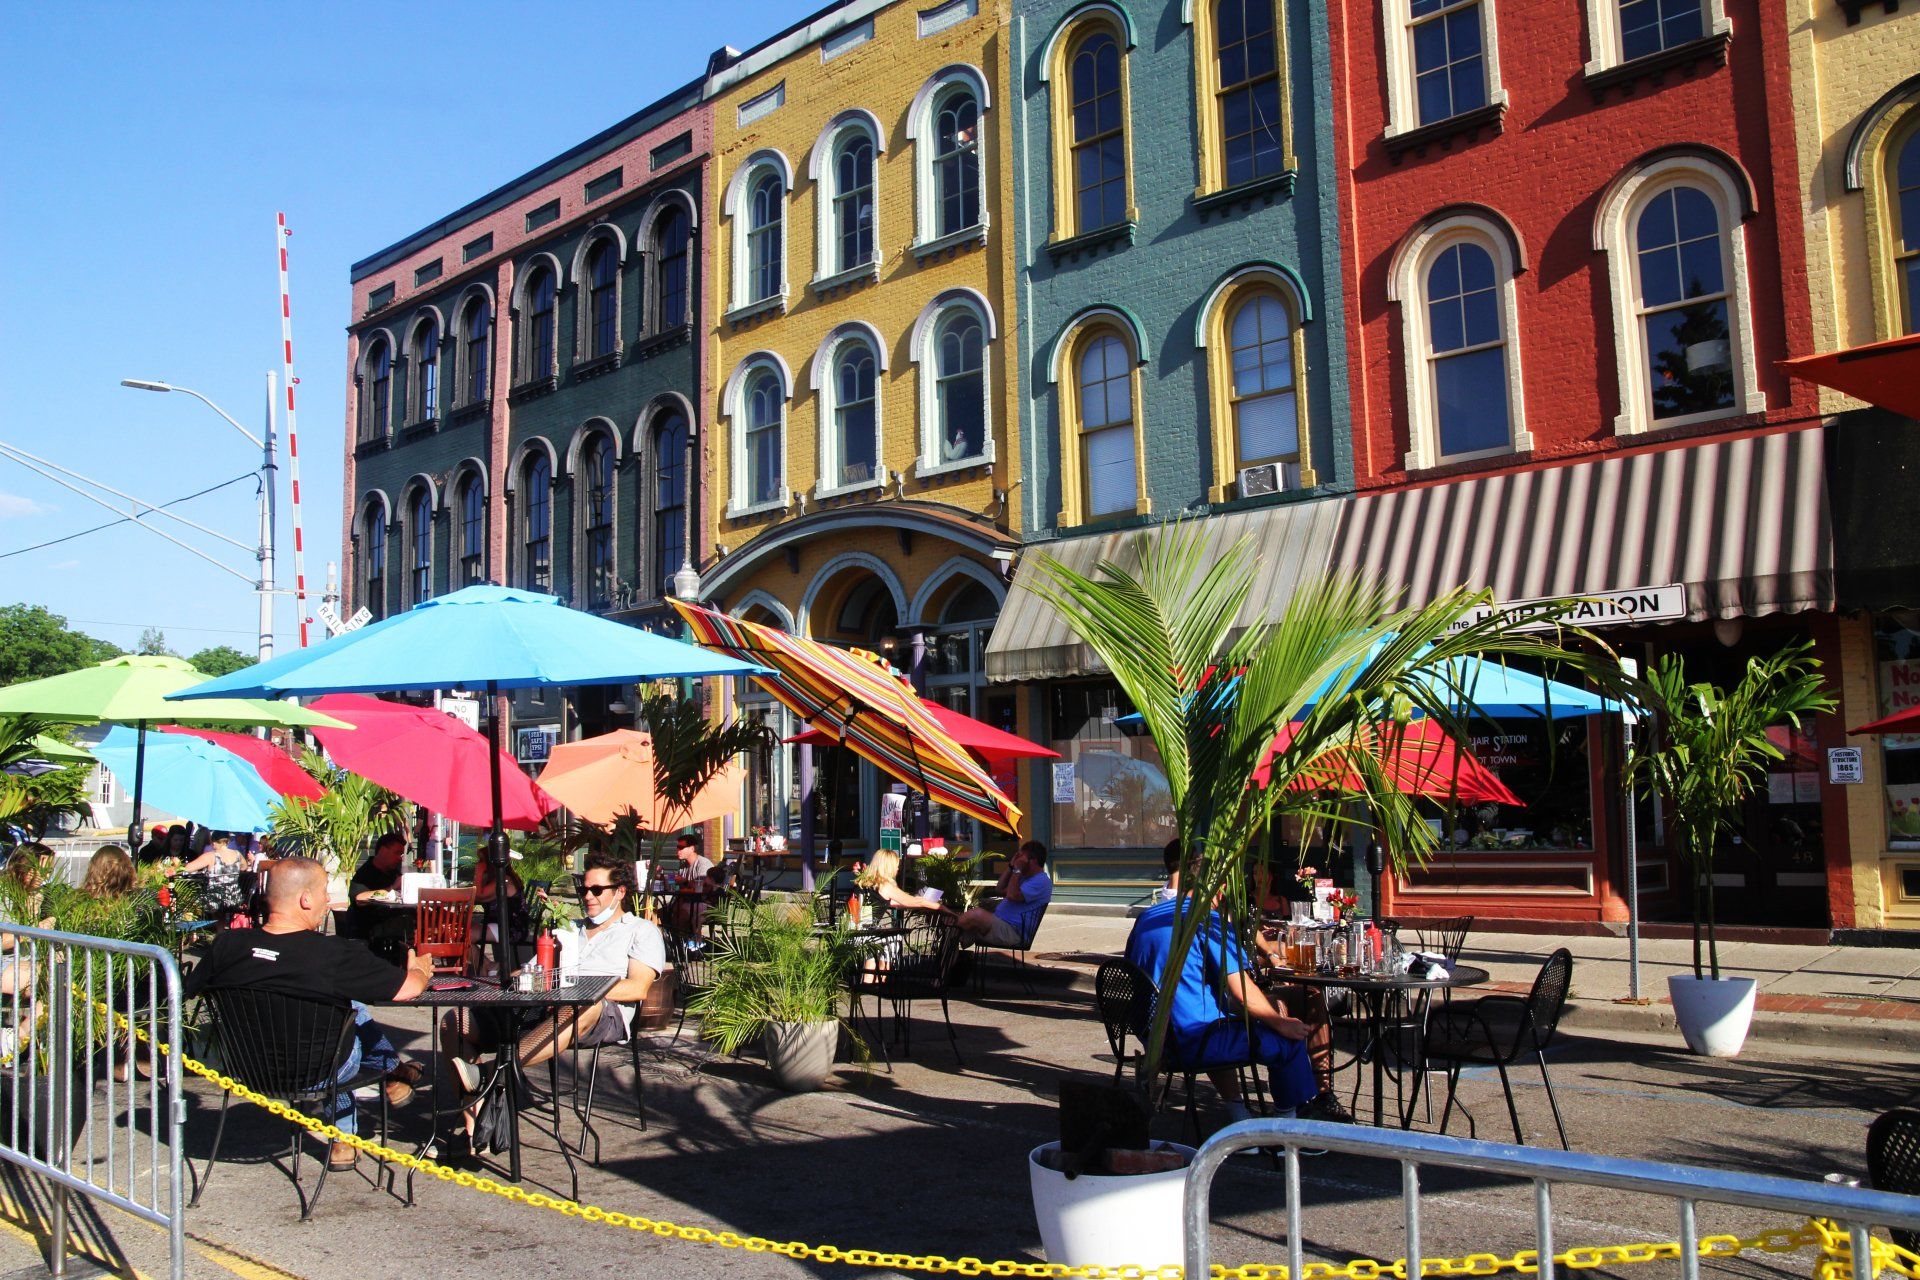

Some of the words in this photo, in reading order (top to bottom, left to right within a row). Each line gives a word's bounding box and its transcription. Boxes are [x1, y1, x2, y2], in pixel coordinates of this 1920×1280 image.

[319, 606, 341, 633] RAIL
[454, 705, 467, 713] NO
[1493, 735, 1528, 752] STATION
[1490, 756, 1517, 765] TOWN
[1837, 764, 1854, 772] 1865
